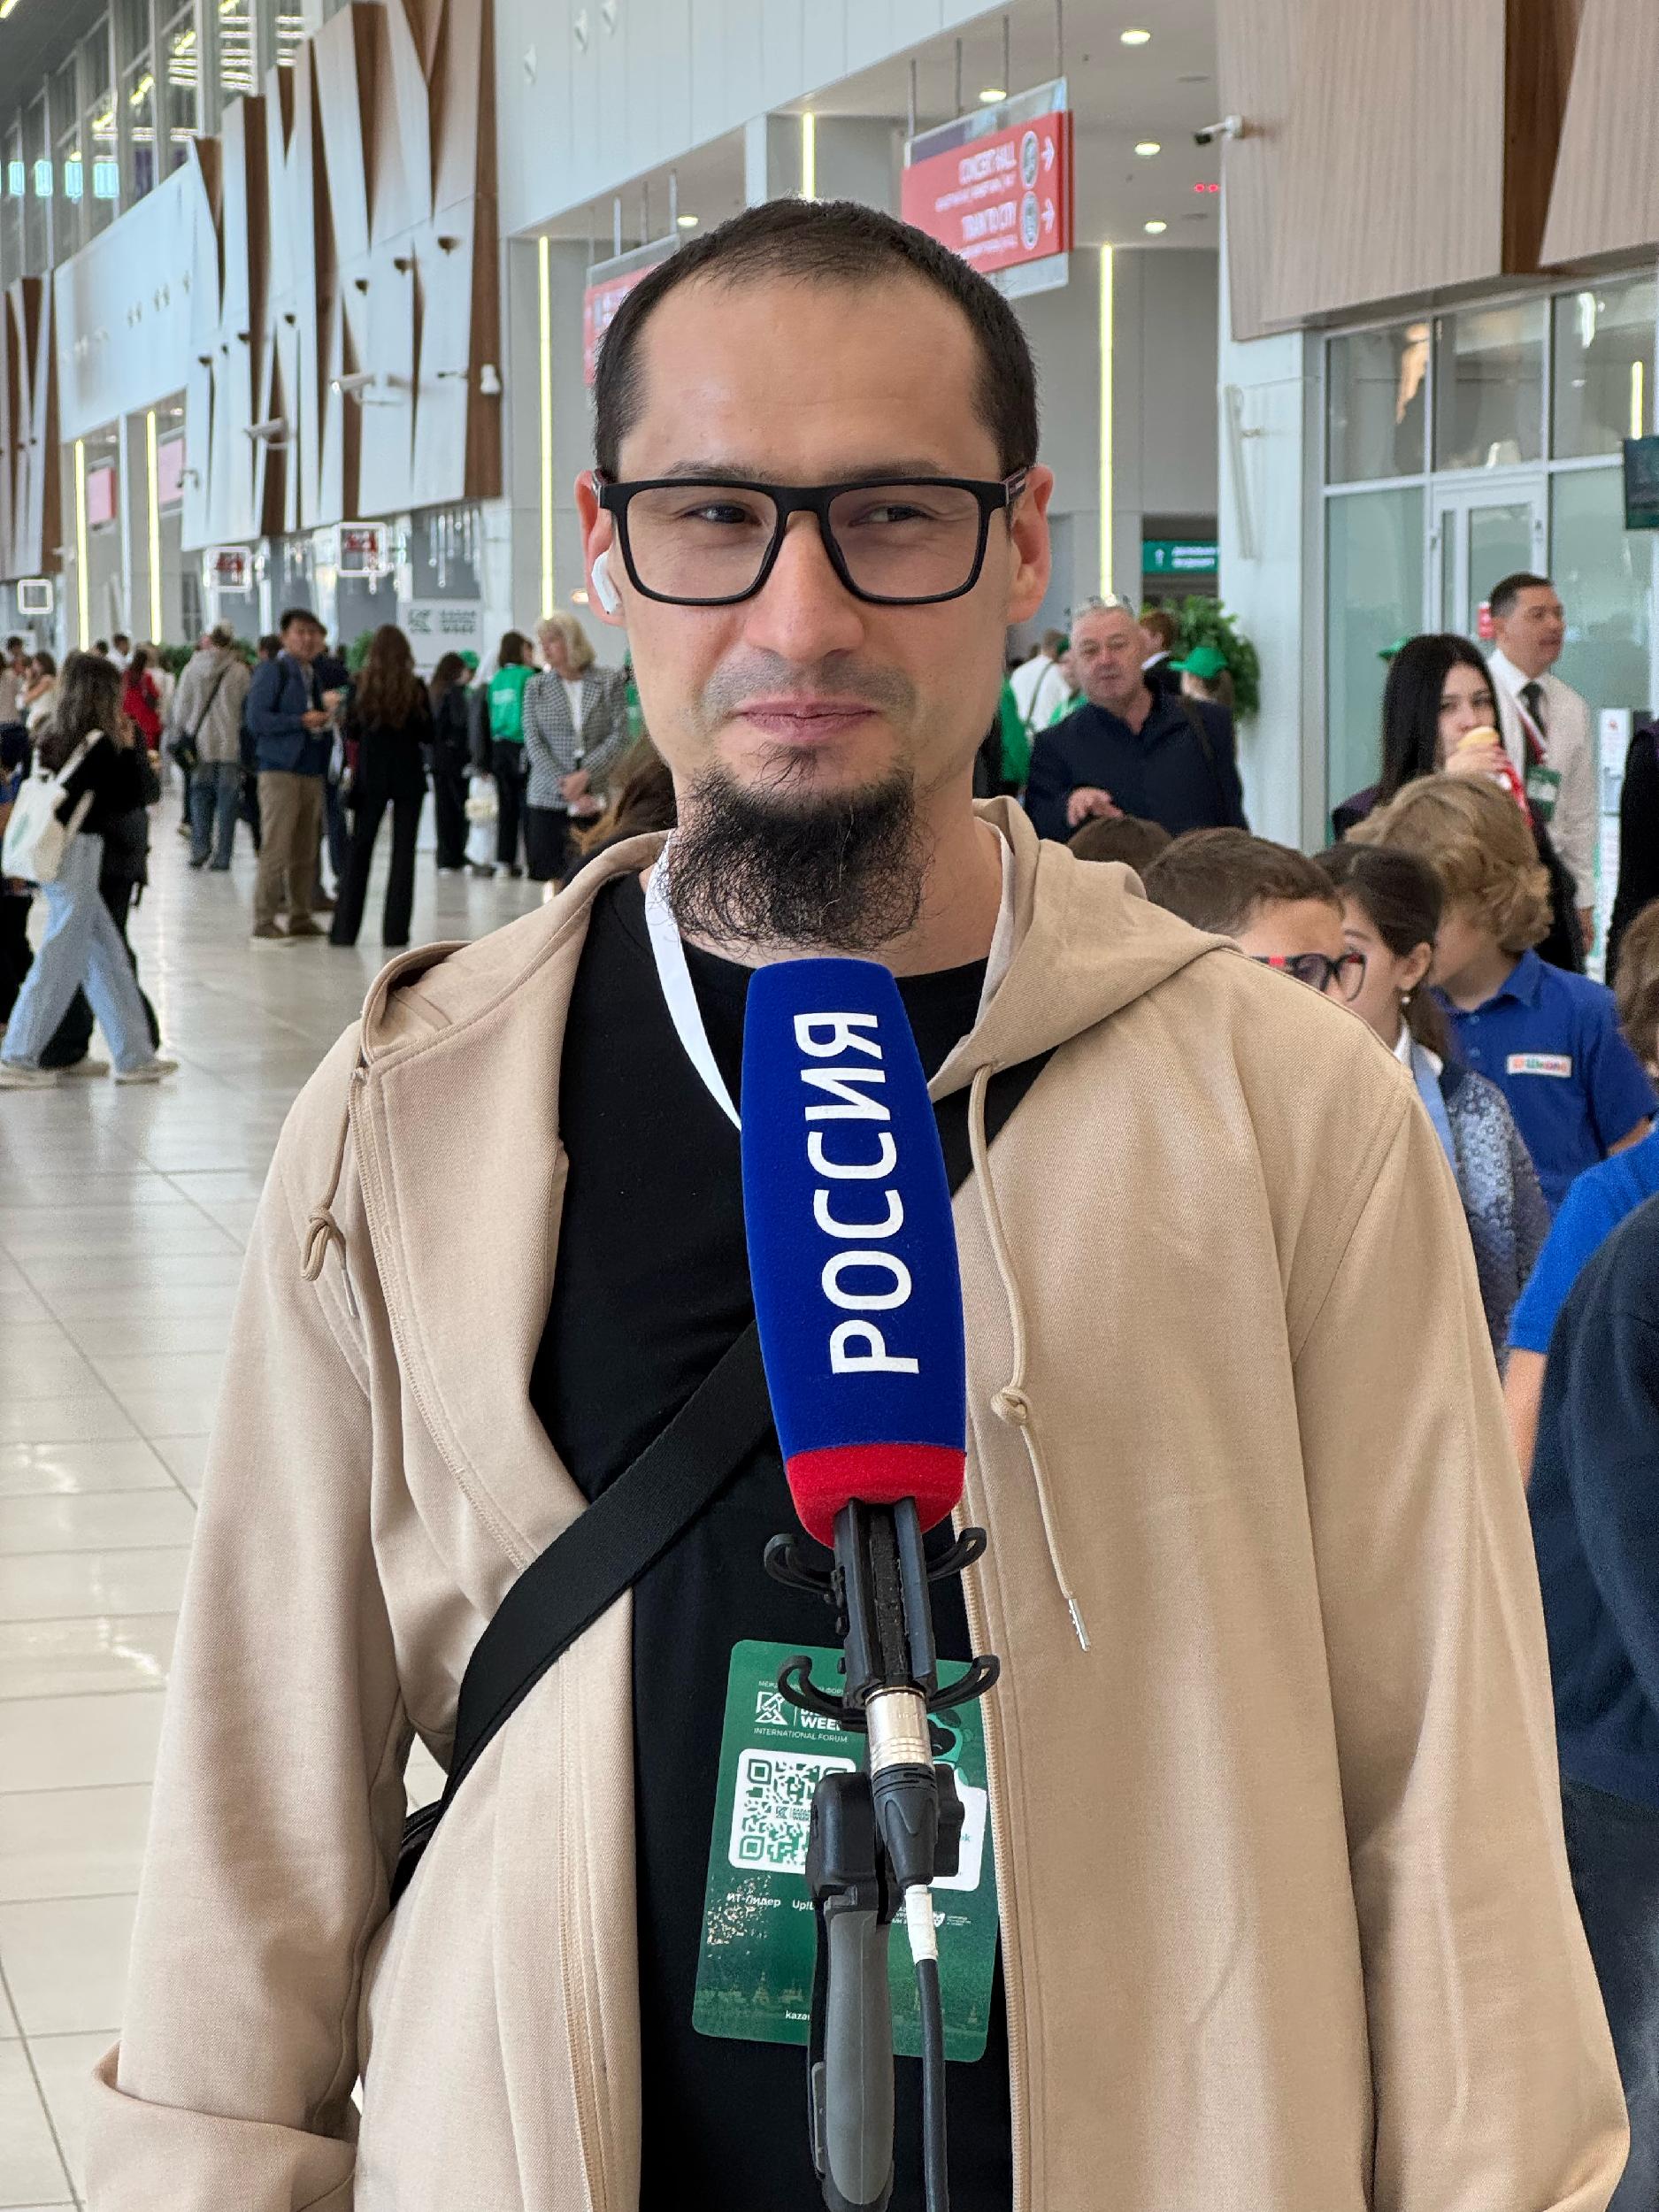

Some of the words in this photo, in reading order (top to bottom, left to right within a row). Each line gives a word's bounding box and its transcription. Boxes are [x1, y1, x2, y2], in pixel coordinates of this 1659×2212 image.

[793, 1011, 920, 1374] РОССИЯ
[753, 1727, 816, 1740] INTERNATIONAL
[818, 1732, 848, 1743] FORUM
